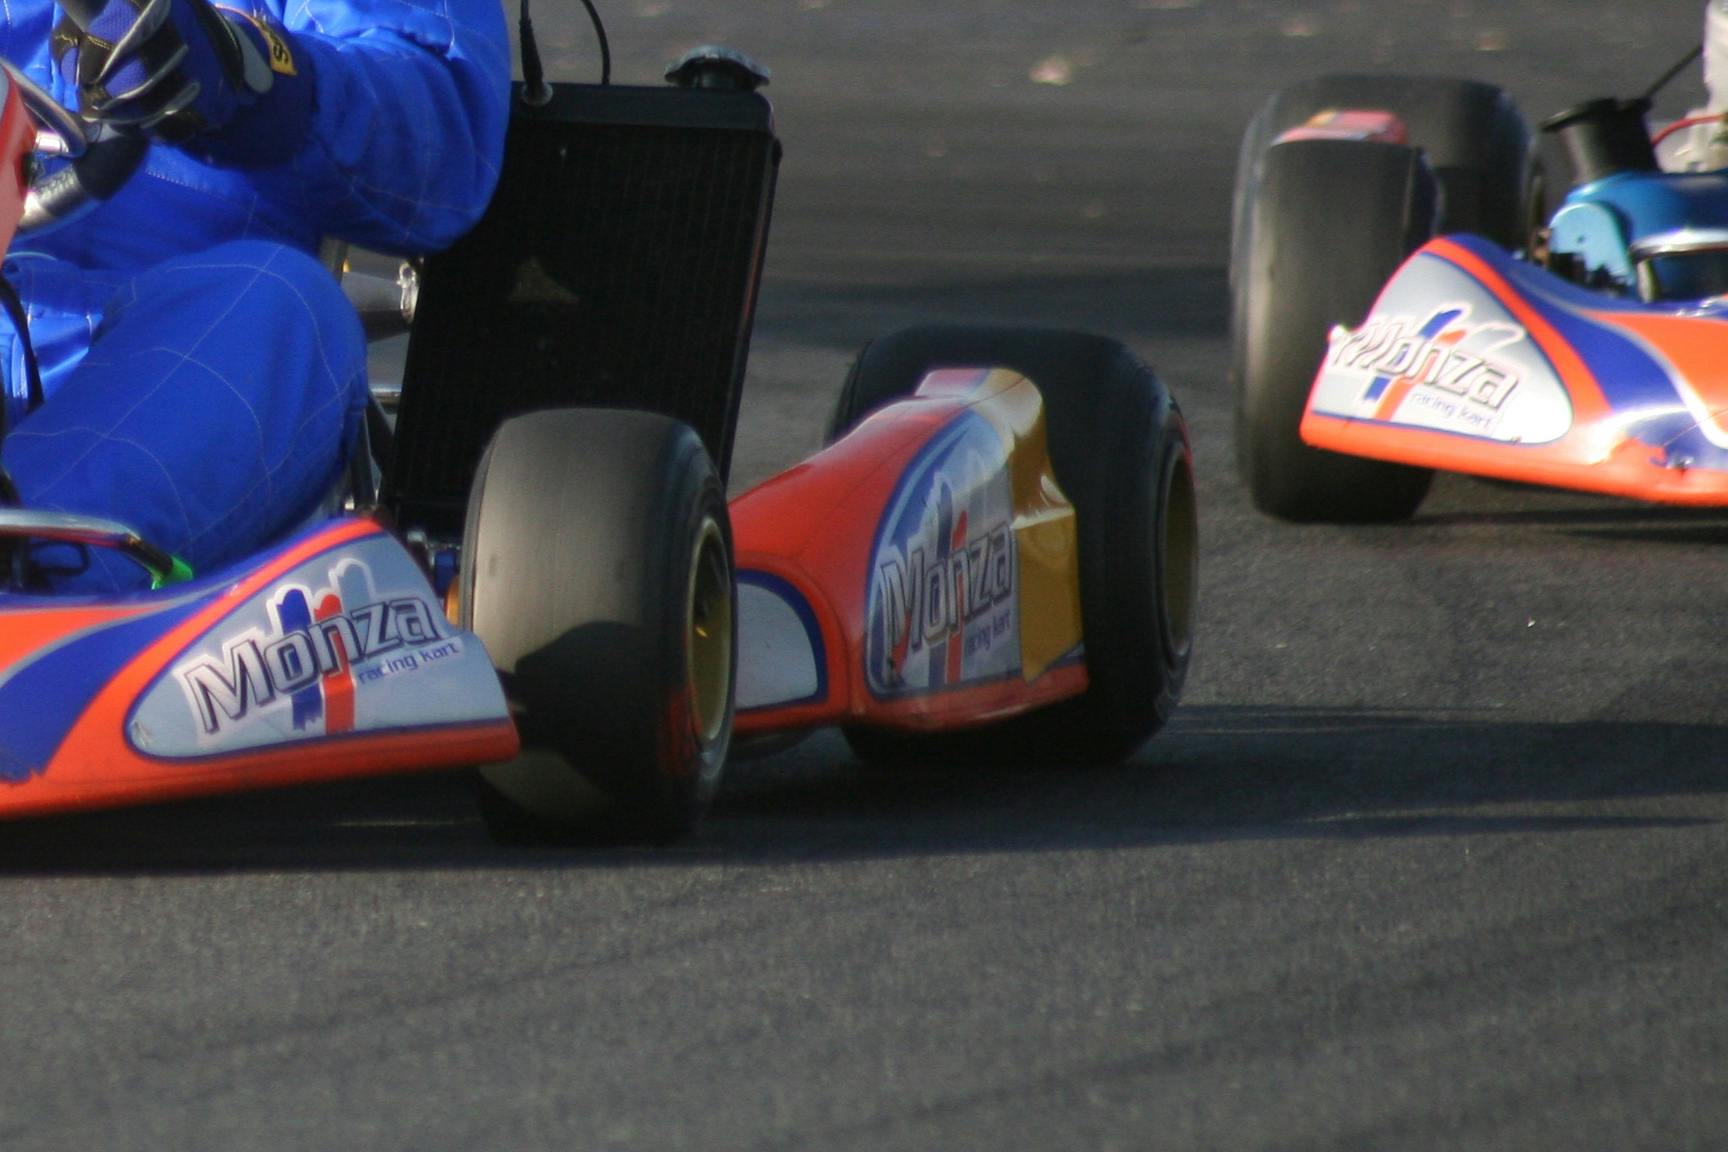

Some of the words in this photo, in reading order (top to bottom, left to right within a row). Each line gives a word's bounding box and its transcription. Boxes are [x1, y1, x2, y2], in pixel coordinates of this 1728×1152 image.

[1334, 322, 1519, 410] Monza
[880, 521, 1013, 678] Monza
[183, 597, 445, 734] Monza
[357, 653, 419, 684] racing
[421, 641, 460, 664] kart
